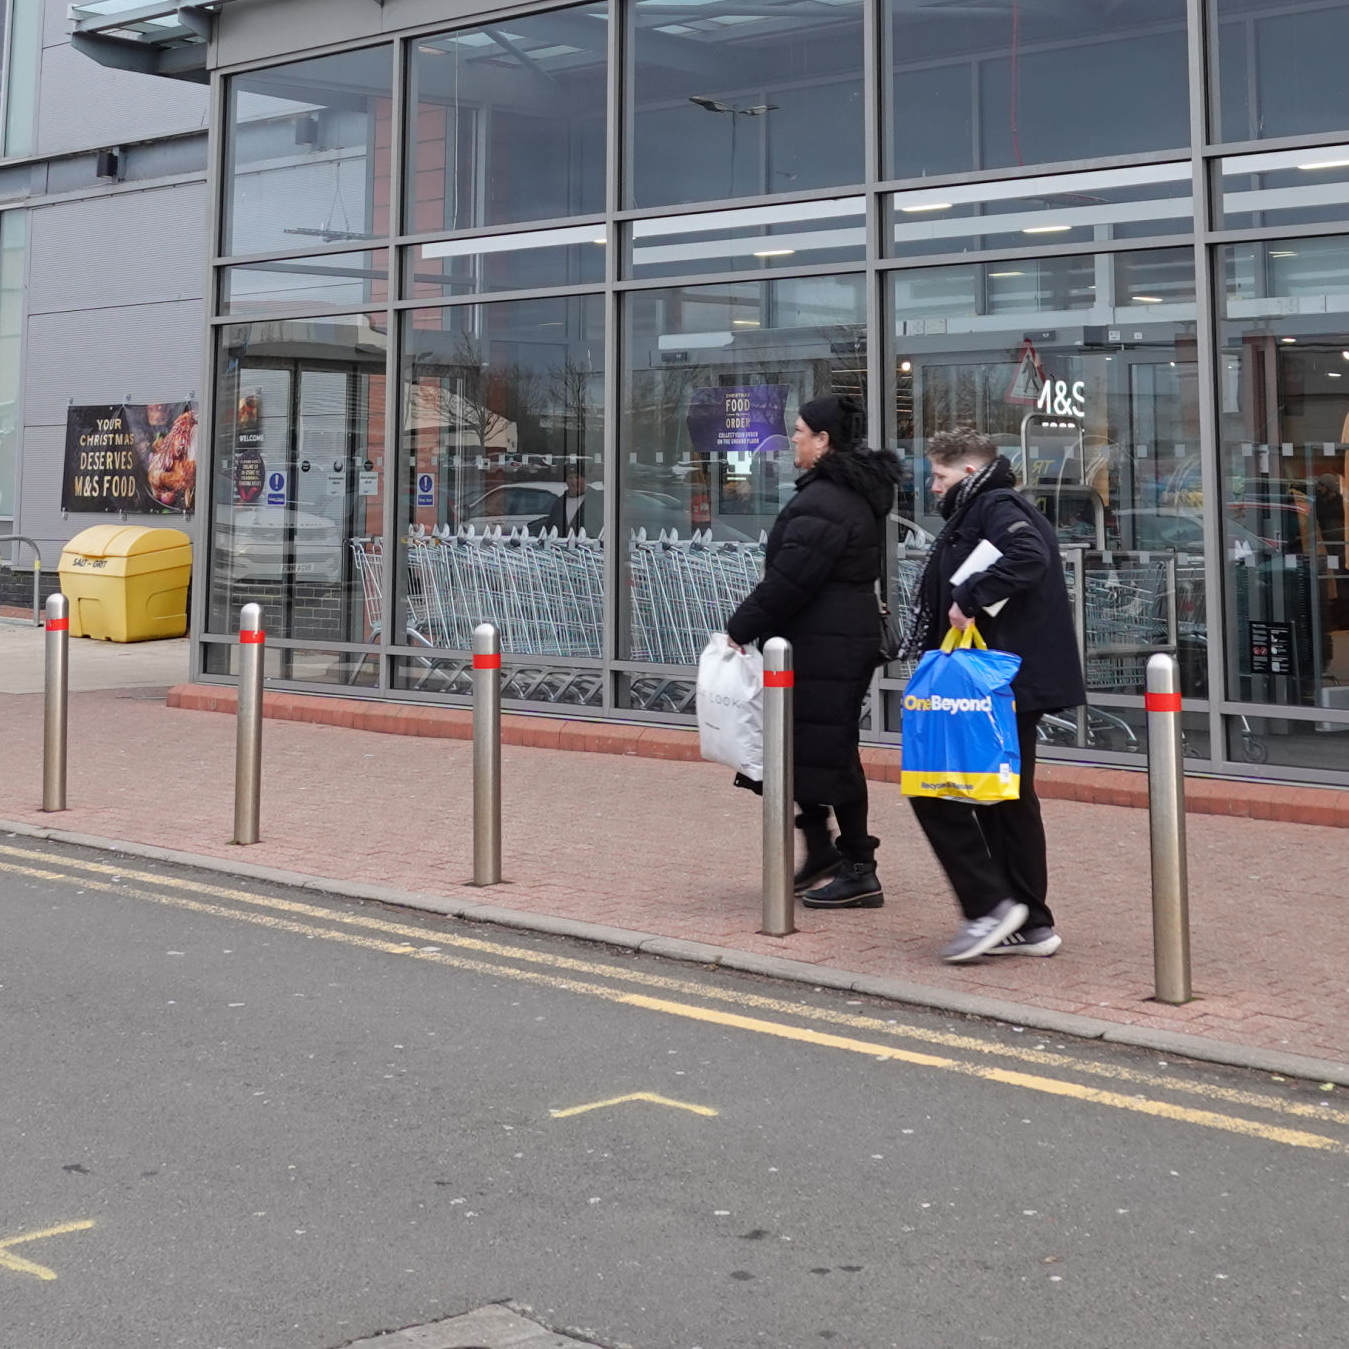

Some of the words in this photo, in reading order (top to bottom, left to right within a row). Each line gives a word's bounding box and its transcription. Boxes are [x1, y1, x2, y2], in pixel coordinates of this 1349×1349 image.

[725, 399, 751, 412] FOOD
[96, 418, 122, 430] YOUR
[725, 418, 751, 429] ORDER
[80, 434, 135, 446] CHRISTMAS
[239, 434, 264, 442] WELCOME
[80, 451, 133, 470] DESERVES
[75, 476, 99, 497] M&S
[103, 476, 136, 497] FOOD
[72, 558, 88, 567] SALT
[92, 560, 108, 569] GRIT
[904, 695, 993, 715] OneBeyond
